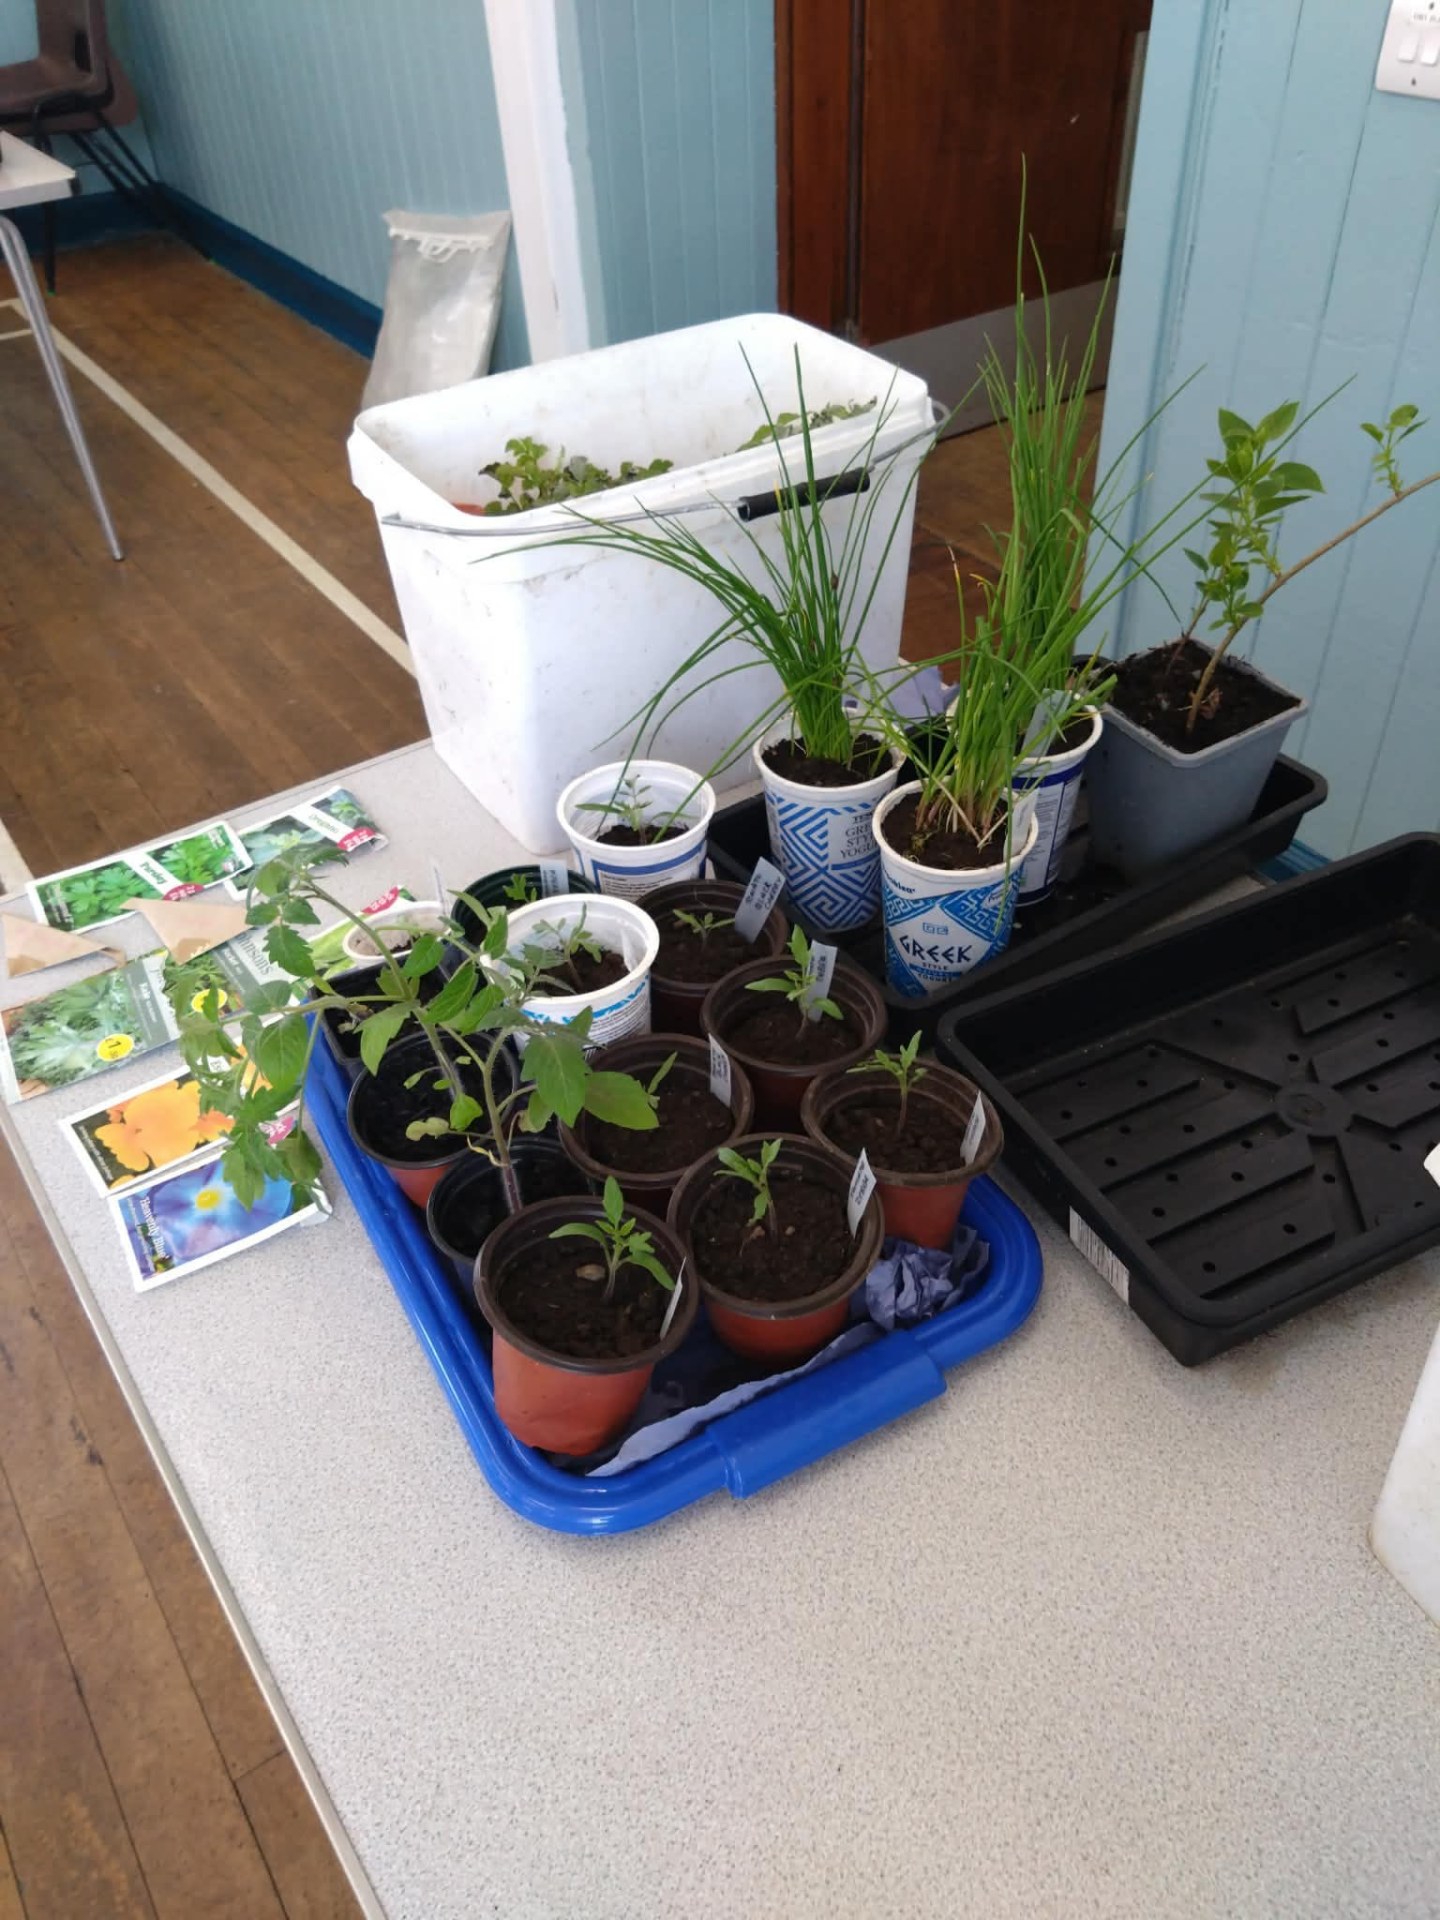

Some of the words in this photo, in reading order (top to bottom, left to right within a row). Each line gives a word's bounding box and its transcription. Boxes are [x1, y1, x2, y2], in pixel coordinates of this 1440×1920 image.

[845, 822, 871, 838] GRE
[899, 935, 972, 964] GREEK
[921, 962, 949, 971] STYLE
